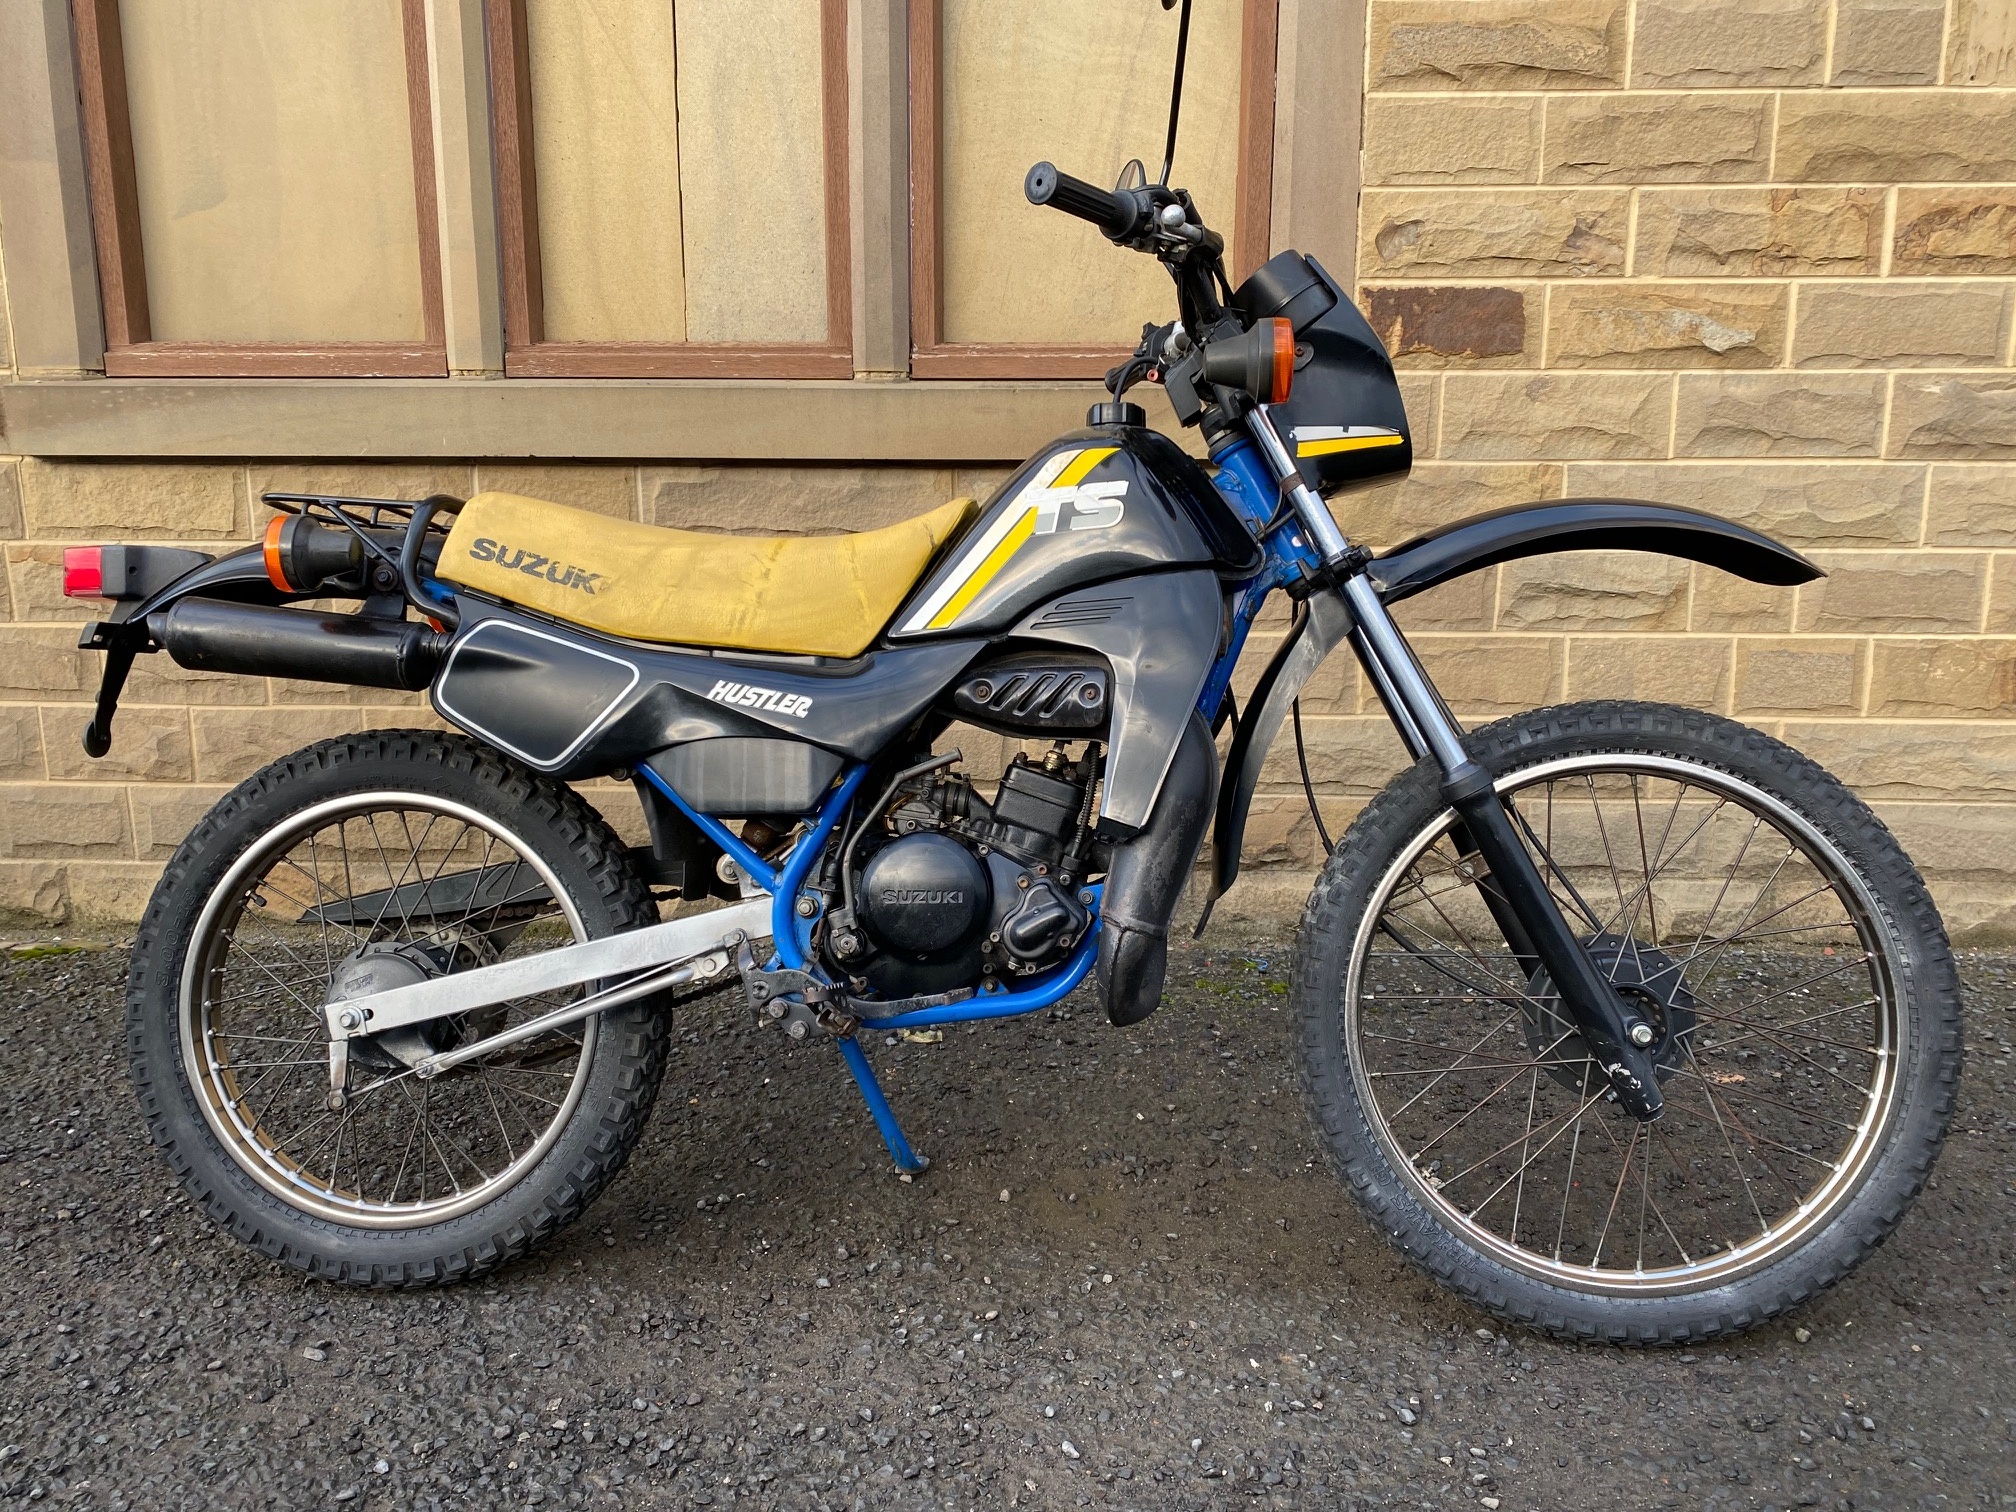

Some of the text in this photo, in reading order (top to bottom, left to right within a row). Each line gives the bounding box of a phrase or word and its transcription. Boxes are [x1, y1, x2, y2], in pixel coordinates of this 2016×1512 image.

[1025, 480, 1130, 535] TS
[469, 537, 611, 595] SUZUK
[706, 679, 814, 718] HUSTLER
[881, 889, 964, 905] SUZUKI
